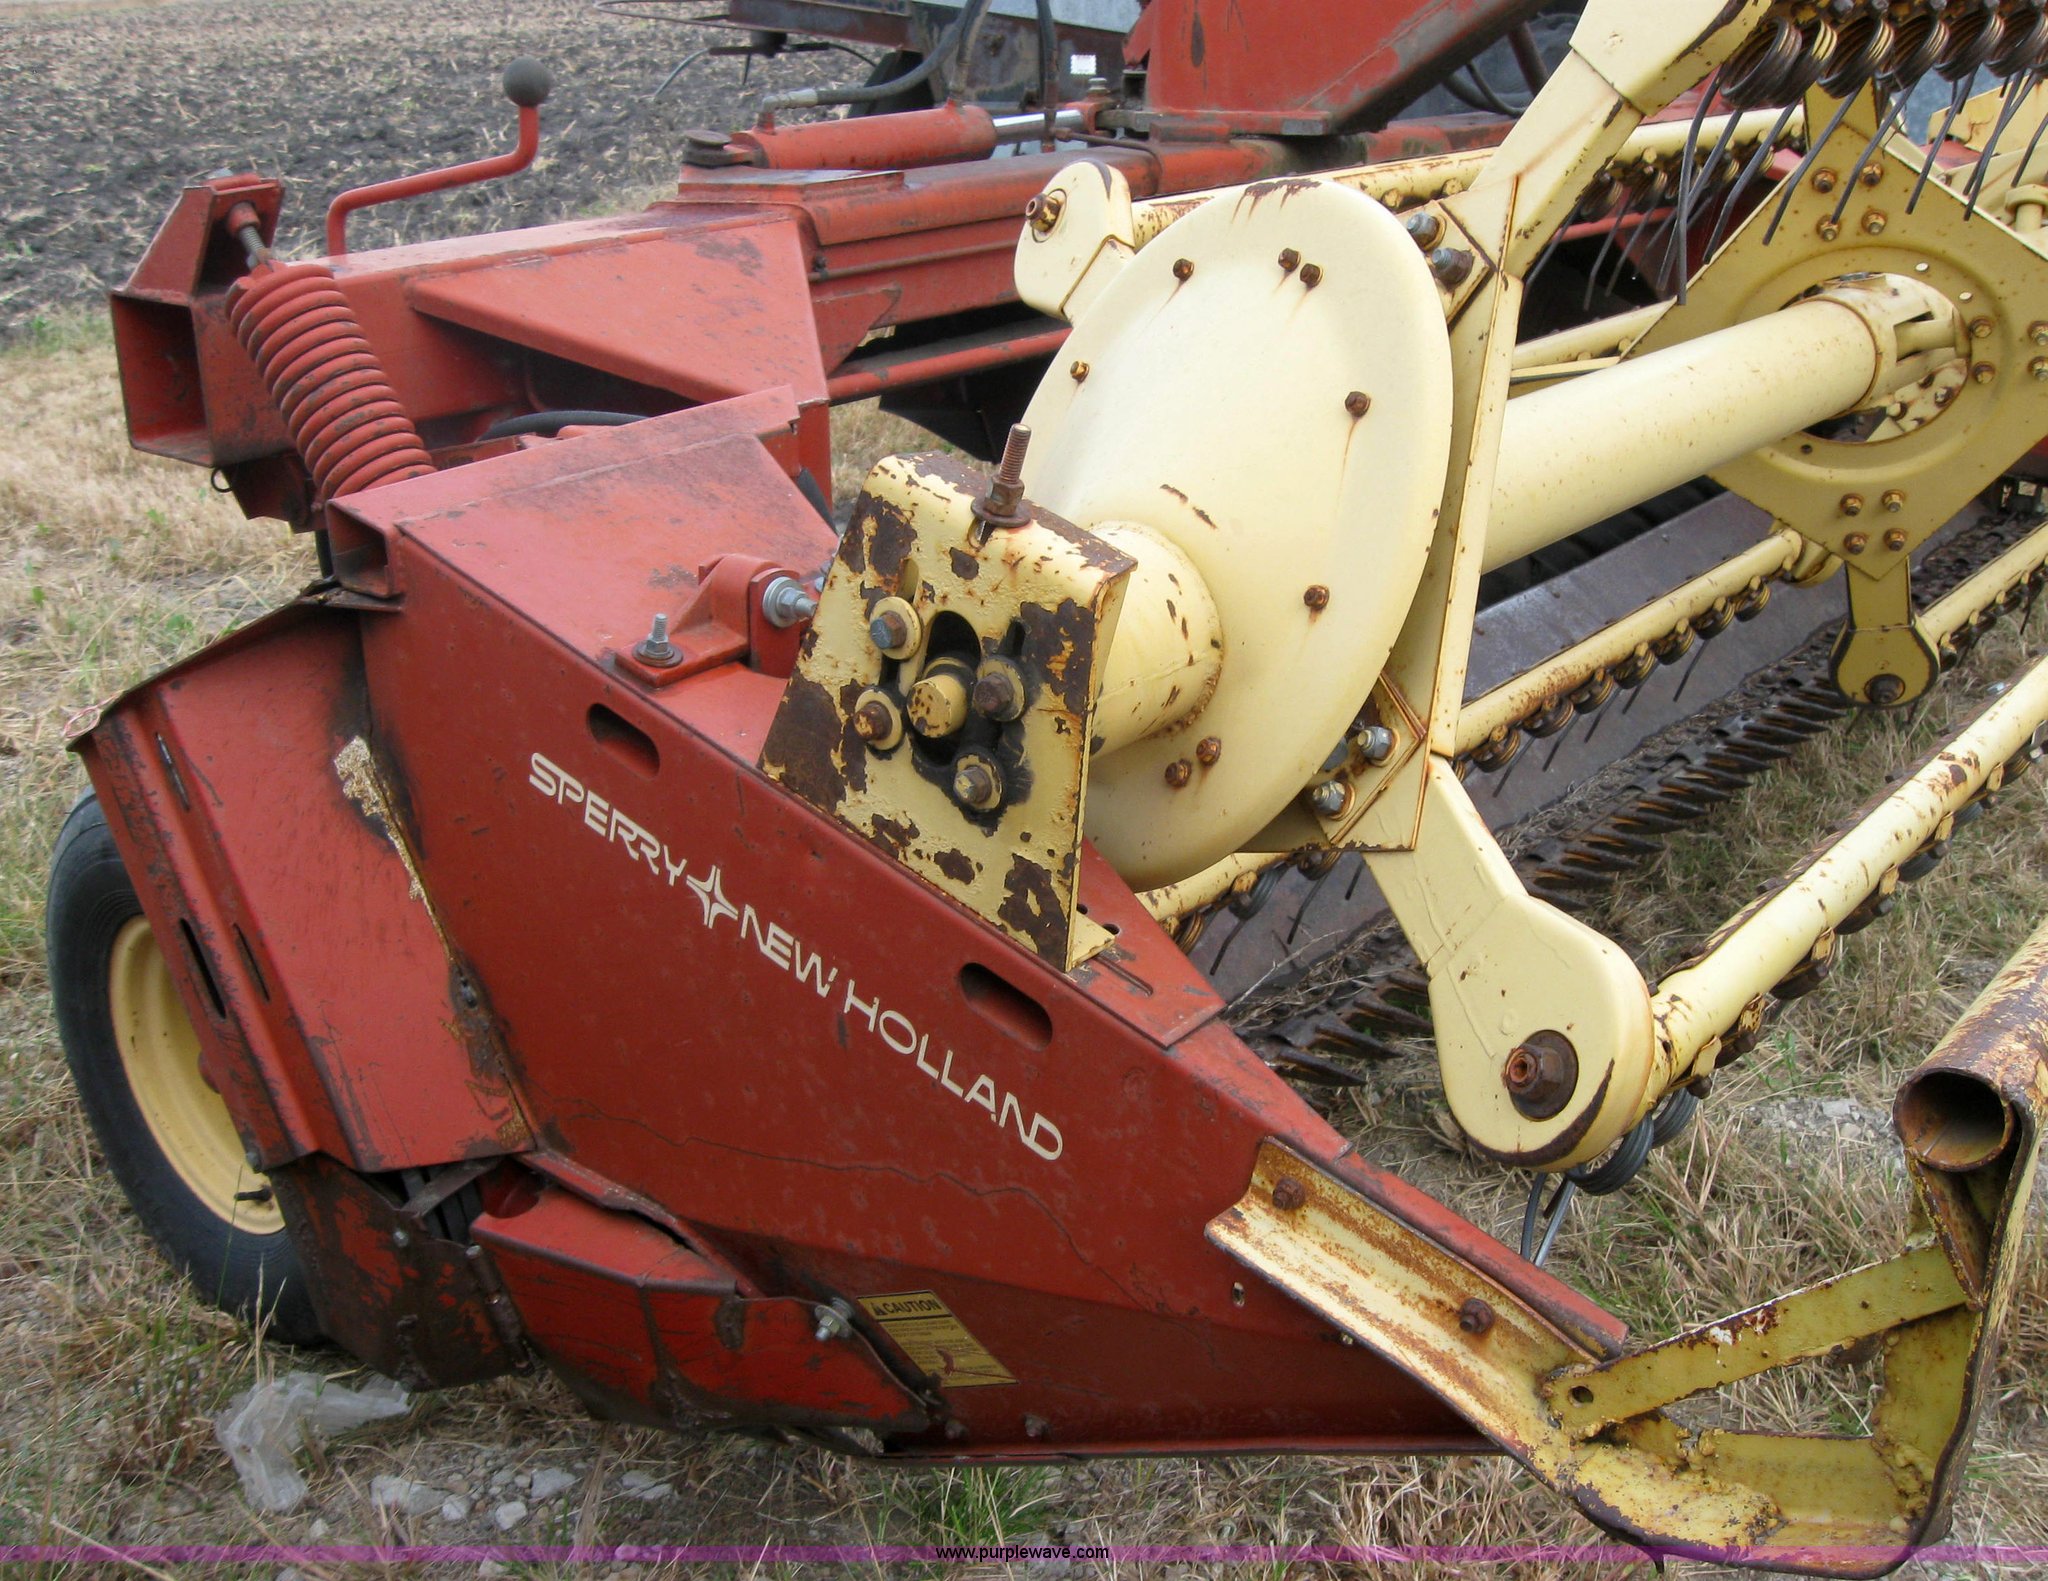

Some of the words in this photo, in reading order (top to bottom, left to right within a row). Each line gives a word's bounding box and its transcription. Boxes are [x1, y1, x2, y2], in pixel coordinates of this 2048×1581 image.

[528, 752, 687, 888] SPERRY
[740, 903, 838, 999] NEW
[843, 979, 1064, 1162] HOLLAND
[884, 1299, 942, 1315] CAUTION
